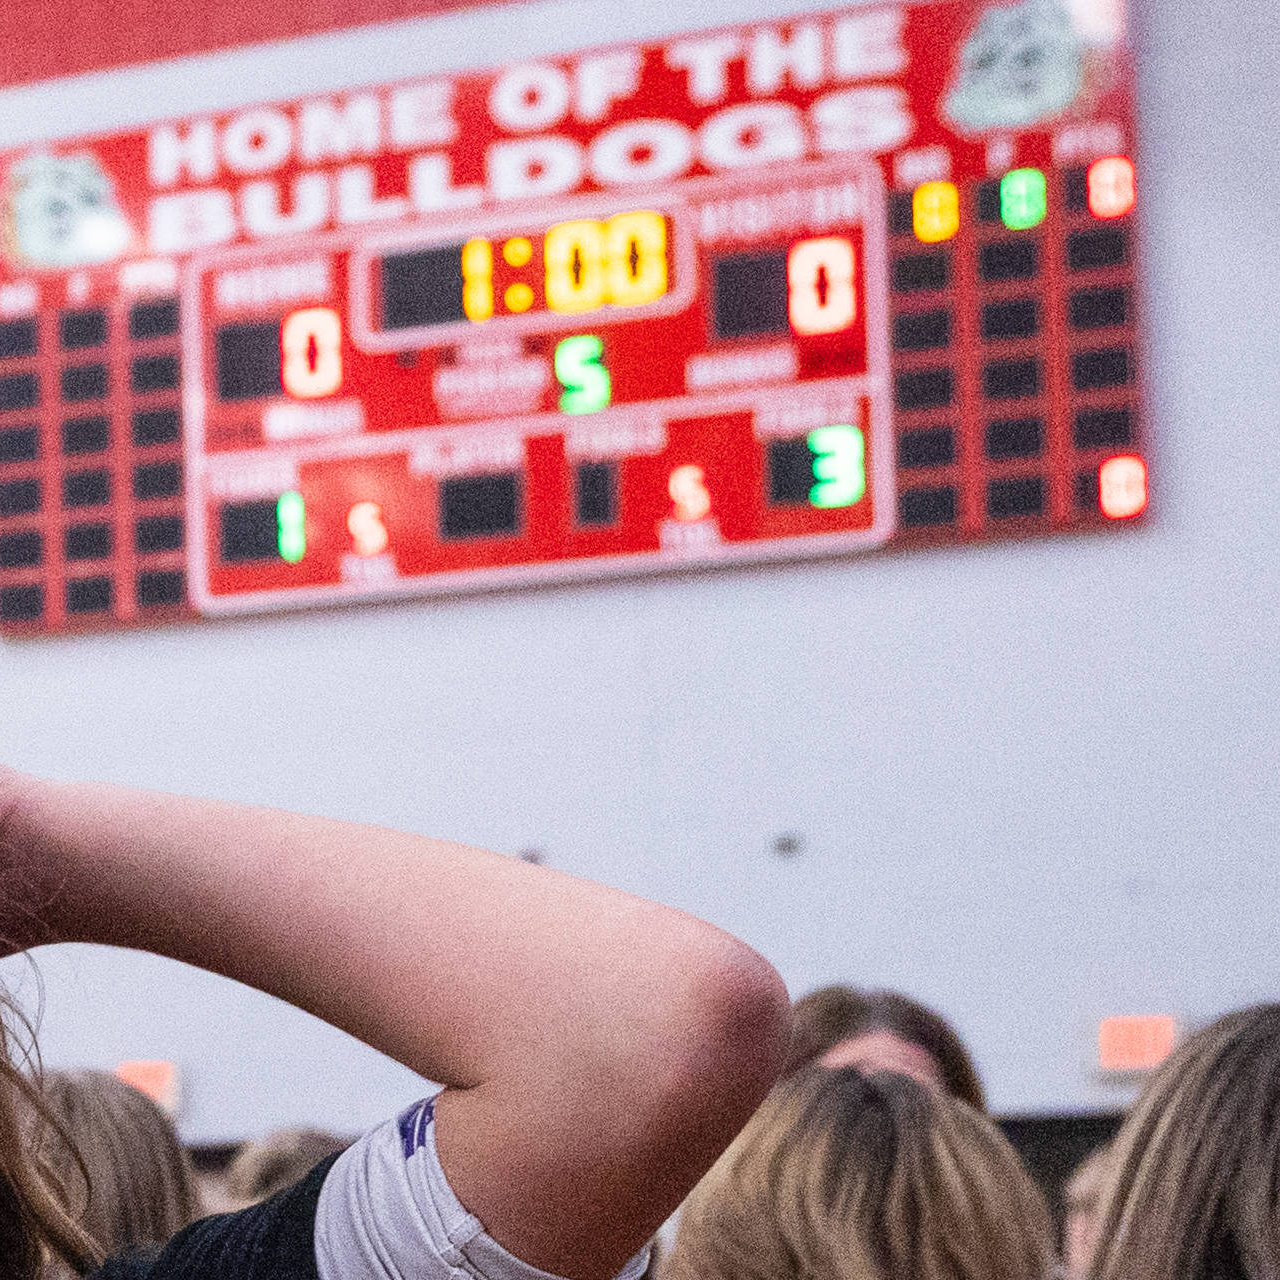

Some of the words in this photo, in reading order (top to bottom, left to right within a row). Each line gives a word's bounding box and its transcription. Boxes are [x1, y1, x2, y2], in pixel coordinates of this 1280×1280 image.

[148, 80, 457, 187] HOME
[489, 48, 641, 131] OF
[668, 8, 907, 106] THE
[148, 83, 915, 253] BULLDOGS
[461, 210, 668, 322] 1:00
[788, 236, 856, 336] 0
[281, 308, 342, 397] 0
[806, 422, 865, 507] 3
[276, 489, 305, 563] 1
